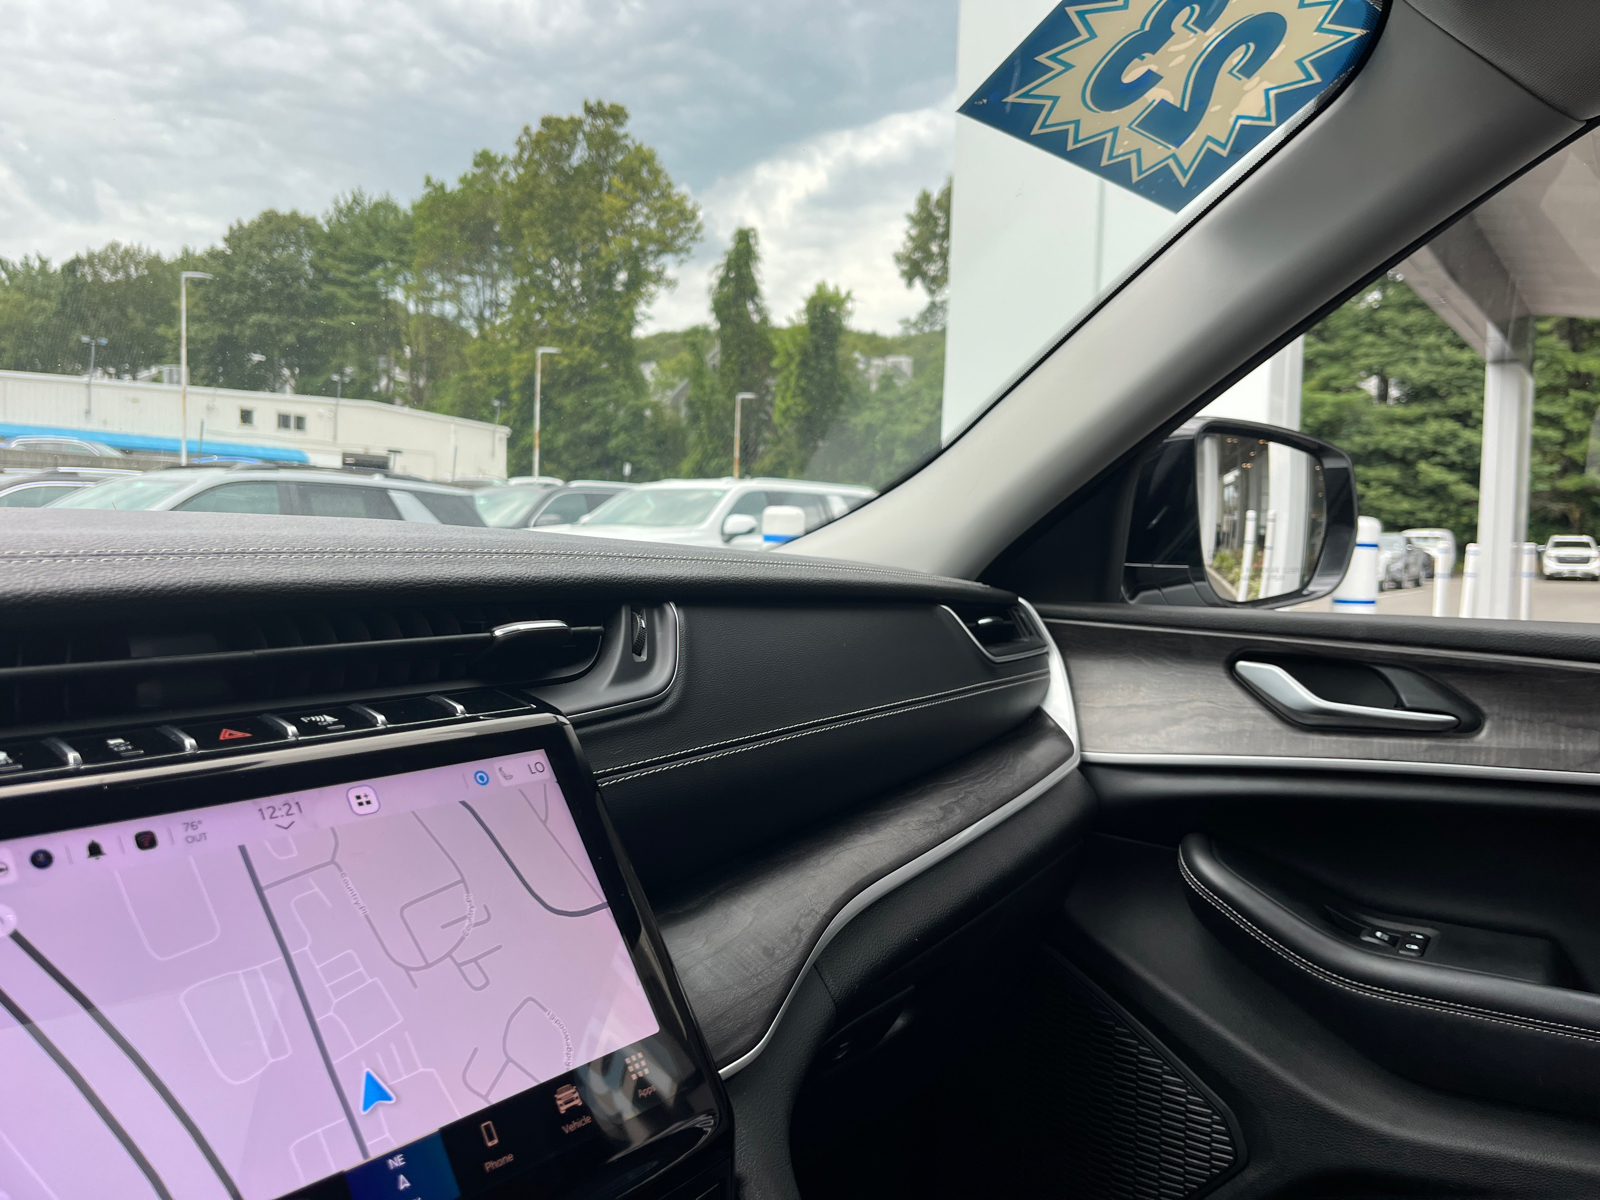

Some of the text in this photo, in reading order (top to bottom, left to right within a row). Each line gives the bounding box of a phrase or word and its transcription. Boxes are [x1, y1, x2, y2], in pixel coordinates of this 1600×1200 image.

[527, 761, 546, 775] LO
[258, 801, 303, 821] 12:21
[185, 832, 208, 844] OUT
[340, 872, 361, 905] Country
[555, 1018, 573, 1067] Ridgewood
[637, 1084, 656, 1099] Apps
[561, 1115, 592, 1134] Vehicle
[387, 1154, 407, 1171] NE
[483, 1153, 515, 1173] Phone
